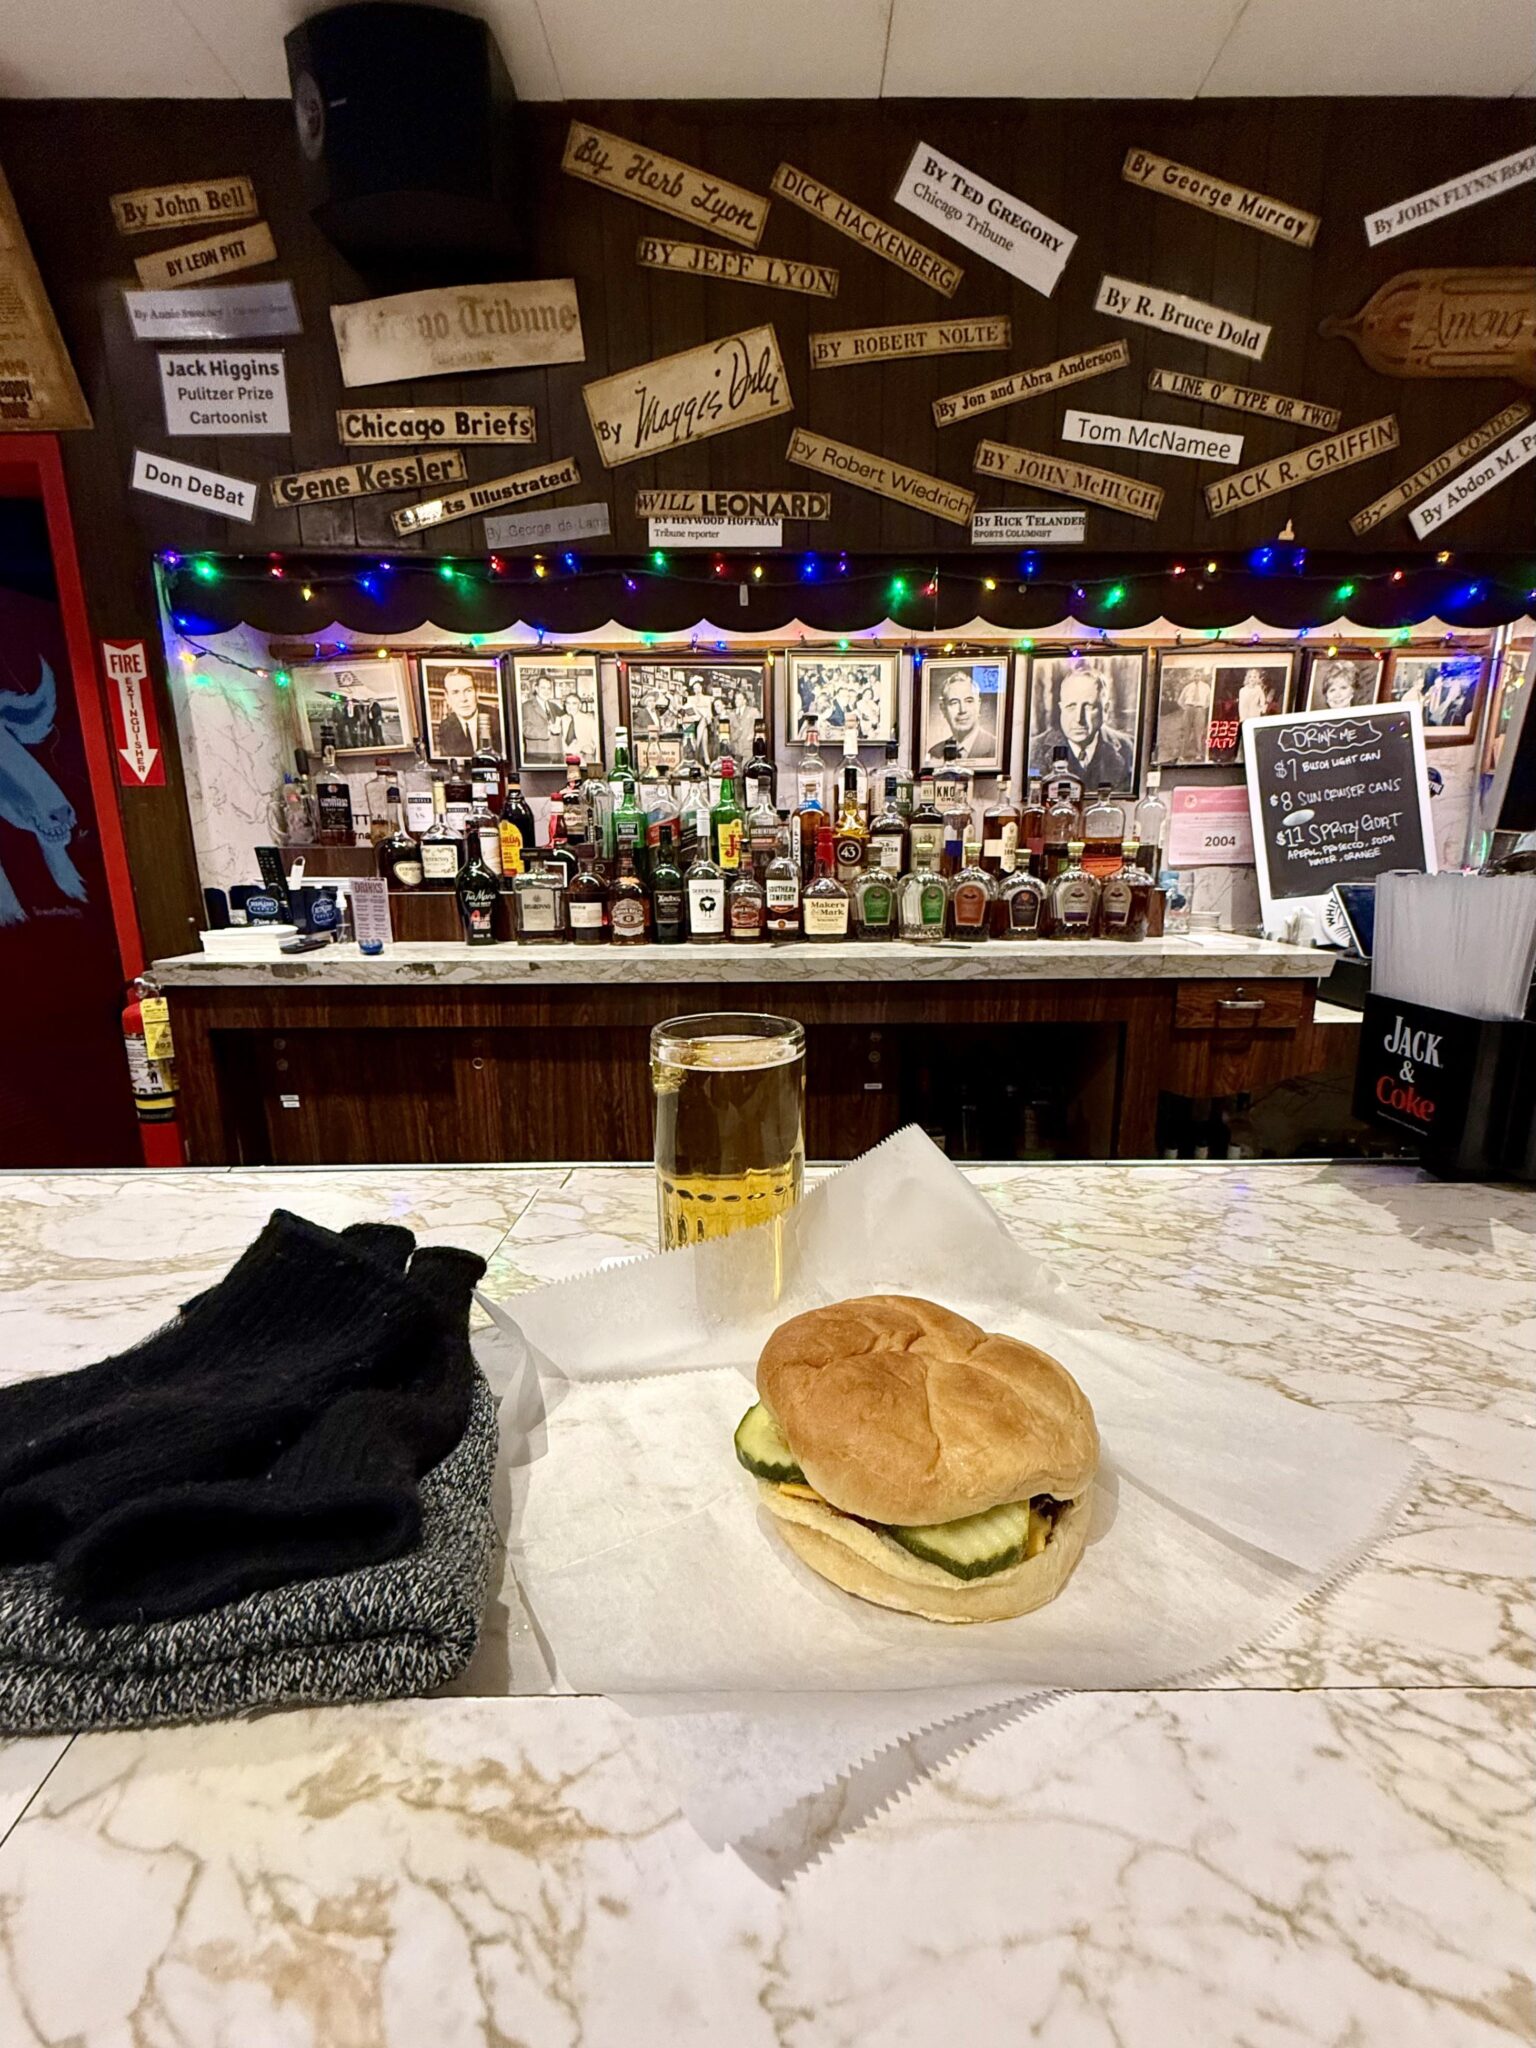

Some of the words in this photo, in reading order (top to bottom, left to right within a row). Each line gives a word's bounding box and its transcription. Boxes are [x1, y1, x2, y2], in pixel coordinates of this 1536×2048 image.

[574, 137, 613, 174] By
[625, 154, 684, 198] Herb
[691, 182, 757, 231] Lyon
[1131, 154, 1155, 181] By
[1163, 166, 1233, 207] George
[1238, 193, 1308, 239] Murray
[121, 201, 149, 224] By
[155, 194, 201, 218] John
[205, 186, 246, 210] Bell
[912, 182, 963, 221] Chicago
[966, 212, 1015, 252] Tribune
[1373, 218, 1394, 235] By
[1397, 196, 1441, 226] JOHN
[782, 169, 826, 212] DICK
[834, 204, 956, 291] HACKENBERG
[166, 259, 184, 278] BY
[186, 252, 218, 272] LEON
[220, 241, 247, 261] PITT
[641, 242, 675, 264] BY
[688, 248, 754, 278] JEFF
[766, 261, 834, 293] LYON
[456, 295, 577, 339] Tribune
[1105, 287, 1131, 314] By
[1135, 295, 1155, 318] R.
[1160, 302, 1214, 335] Bruce
[1217, 320, 1261, 351] Dold
[817, 341, 842, 360] BY
[853, 332, 928, 357] ROBERT
[938, 323, 999, 345] NOLTE
[166, 360, 207, 377] Jack
[210, 360, 280, 381] Higgins
[938, 402, 957, 418] By
[962, 393, 986, 411] Jon
[991, 382, 1015, 400] and
[1020, 372, 1053, 391] Abra
[1058, 348, 1122, 379] Anderson
[178, 387, 234, 401] Pulitzer
[237, 387, 274, 401] Prize
[1153, 372, 1163, 388] A
[1171, 377, 1203, 397] LINE
[1234, 388, 1270, 412] TYPE
[1275, 399, 1296, 417] OR
[1302, 405, 1333, 427] TWO
[190, 411, 268, 425] Cartoonist
[345, 413, 446, 440] Chicago
[455, 411, 533, 436] Briefs
[599, 420, 622, 445] By
[1078, 418, 1121, 442] Tom
[1128, 425, 1231, 459] McNamee
[1400, 456, 1451, 500] DAVID
[1458, 405, 1524, 459] CONDON
[280, 475, 351, 502] Gene
[356, 456, 454, 492] Kessler
[795, 437, 817, 460] by
[822, 447, 886, 483] Robert
[891, 471, 969, 515] Wiedrich
[980, 449, 1010, 470] BY
[1014, 459, 1069, 485] JOHN
[1073, 471, 1156, 511] McHUGH
[1215, 469, 1272, 510] JACK
[1279, 462, 1299, 483] R.
[1306, 422, 1395, 472] GRIFFIN
[145, 463, 183, 489] Don
[187, 475, 245, 507] DeBat
[470, 467, 575, 507] Illustrated
[1420, 504, 1443, 526] By
[1447, 467, 1496, 508] Abdon
[1496, 448, 1520, 471] M.
[638, 494, 697, 513] WILL
[702, 494, 827, 518] LEONARD
[508, 521, 552, 539] George
[654, 529, 685, 538] Tribune
[687, 530, 720, 540] reporter
[109, 654, 143, 674] FIRE
[124, 678, 145, 773] EXTINGUISHER
[1292, 728, 1338, 749] DRINK
[1339, 728, 1358, 743] ME
[1274, 758, 1298, 781] $7
[1302, 760, 1331, 774] BUSCH
[1332, 755, 1359, 769] LIGHT
[1360, 750, 1382, 763] CAN
[936, 786, 955, 797] KNO
[1269, 792, 1293, 812] $8
[1298, 790, 1322, 807] SUN
[1324, 784, 1366, 803] CRUISER
[1368, 778, 1402, 794] CANS
[839, 847, 857, 858] 43
[1204, 836, 1236, 848] 2004
[1275, 827, 1305, 848] $11
[1371, 834, 1396, 846] SODA
[768, 886, 797, 894] SOUTHERN
[769, 894, 795, 902] COMFORT
[811, 901, 845, 909] Maker's
[1383, 1015, 1442, 1068] JACK
[1399, 1060, 1415, 1083] &
[1376, 1075, 1436, 1122] Coke
